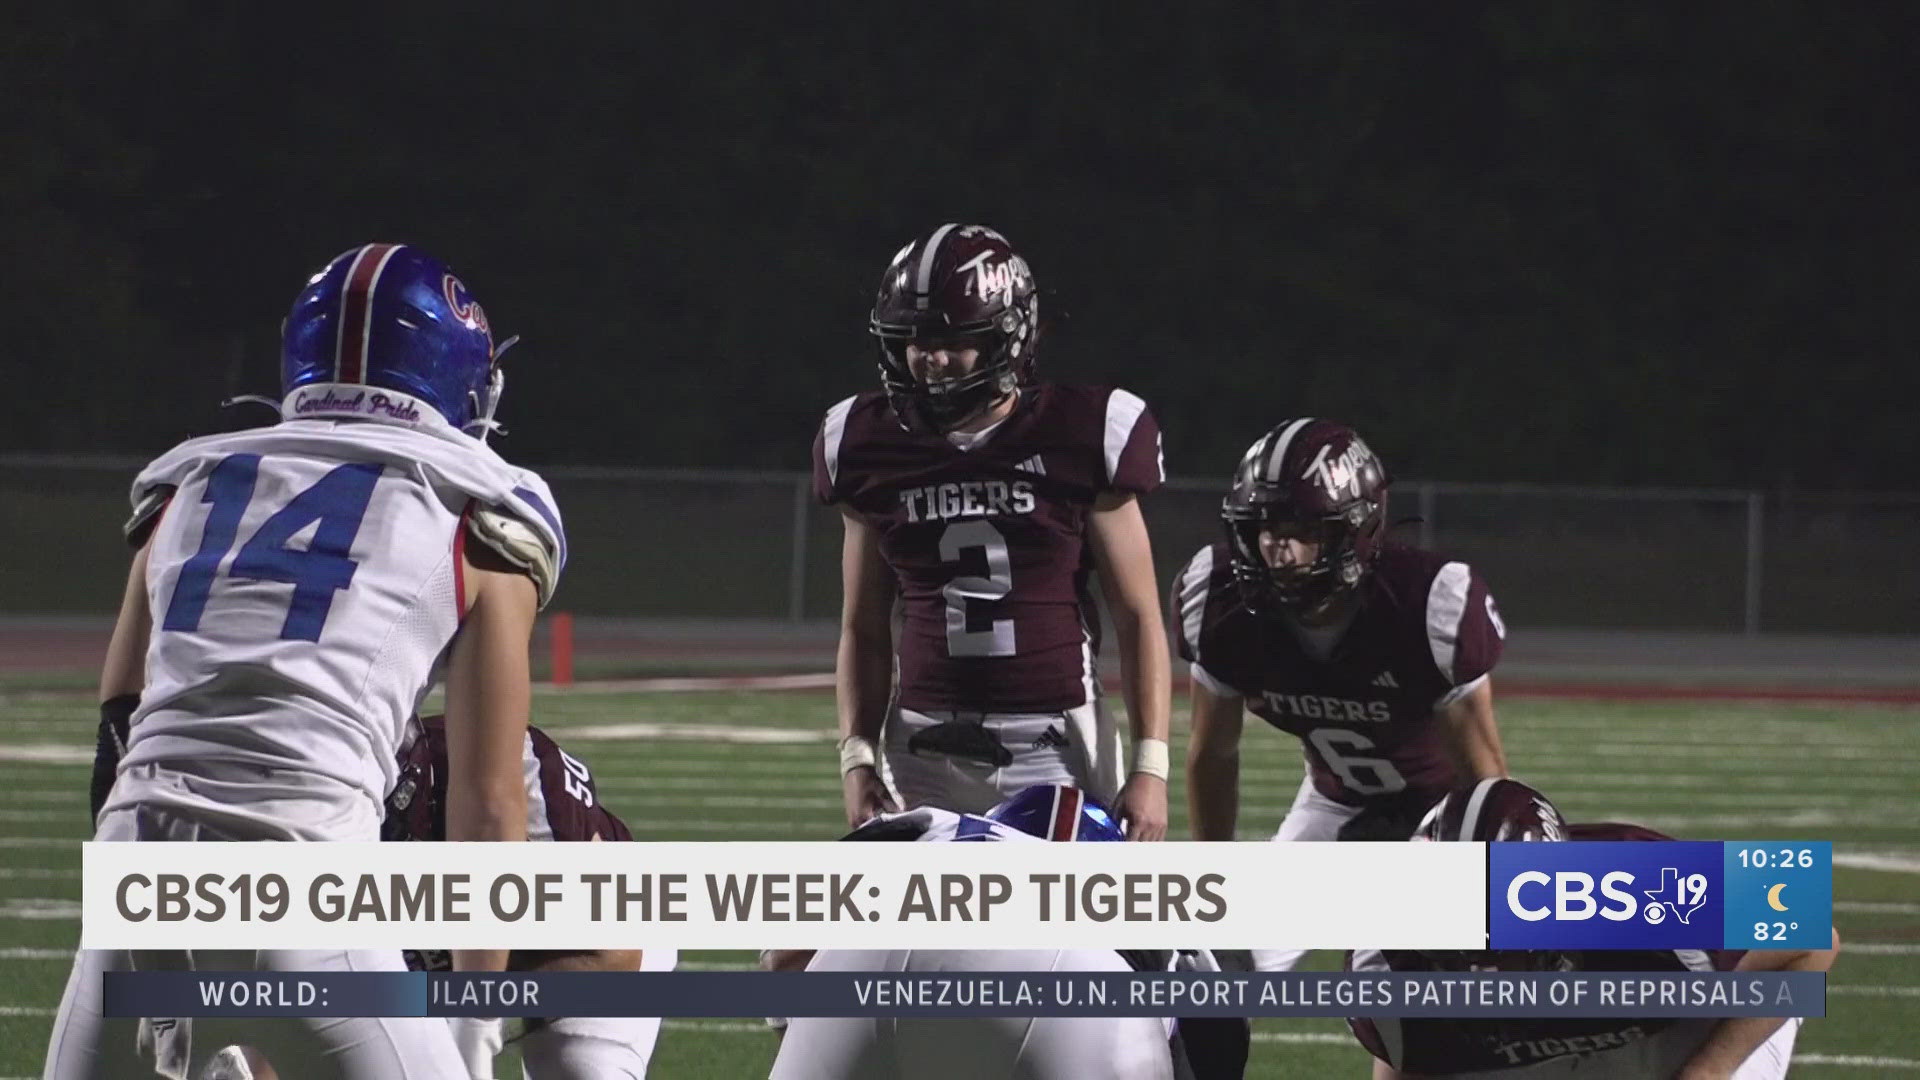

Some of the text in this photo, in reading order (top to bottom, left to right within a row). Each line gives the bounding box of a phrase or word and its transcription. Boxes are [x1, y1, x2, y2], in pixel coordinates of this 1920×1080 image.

[294, 389, 420, 421] Cardinal Pride
[900, 481, 1036, 523] TIGERS
[162, 453, 385, 643] 14
[939, 520, 1016, 656] 2
[1262, 690, 1391, 723] TIGERS
[558, 747, 593, 808] 50
[1308, 728, 1407, 795] 6
